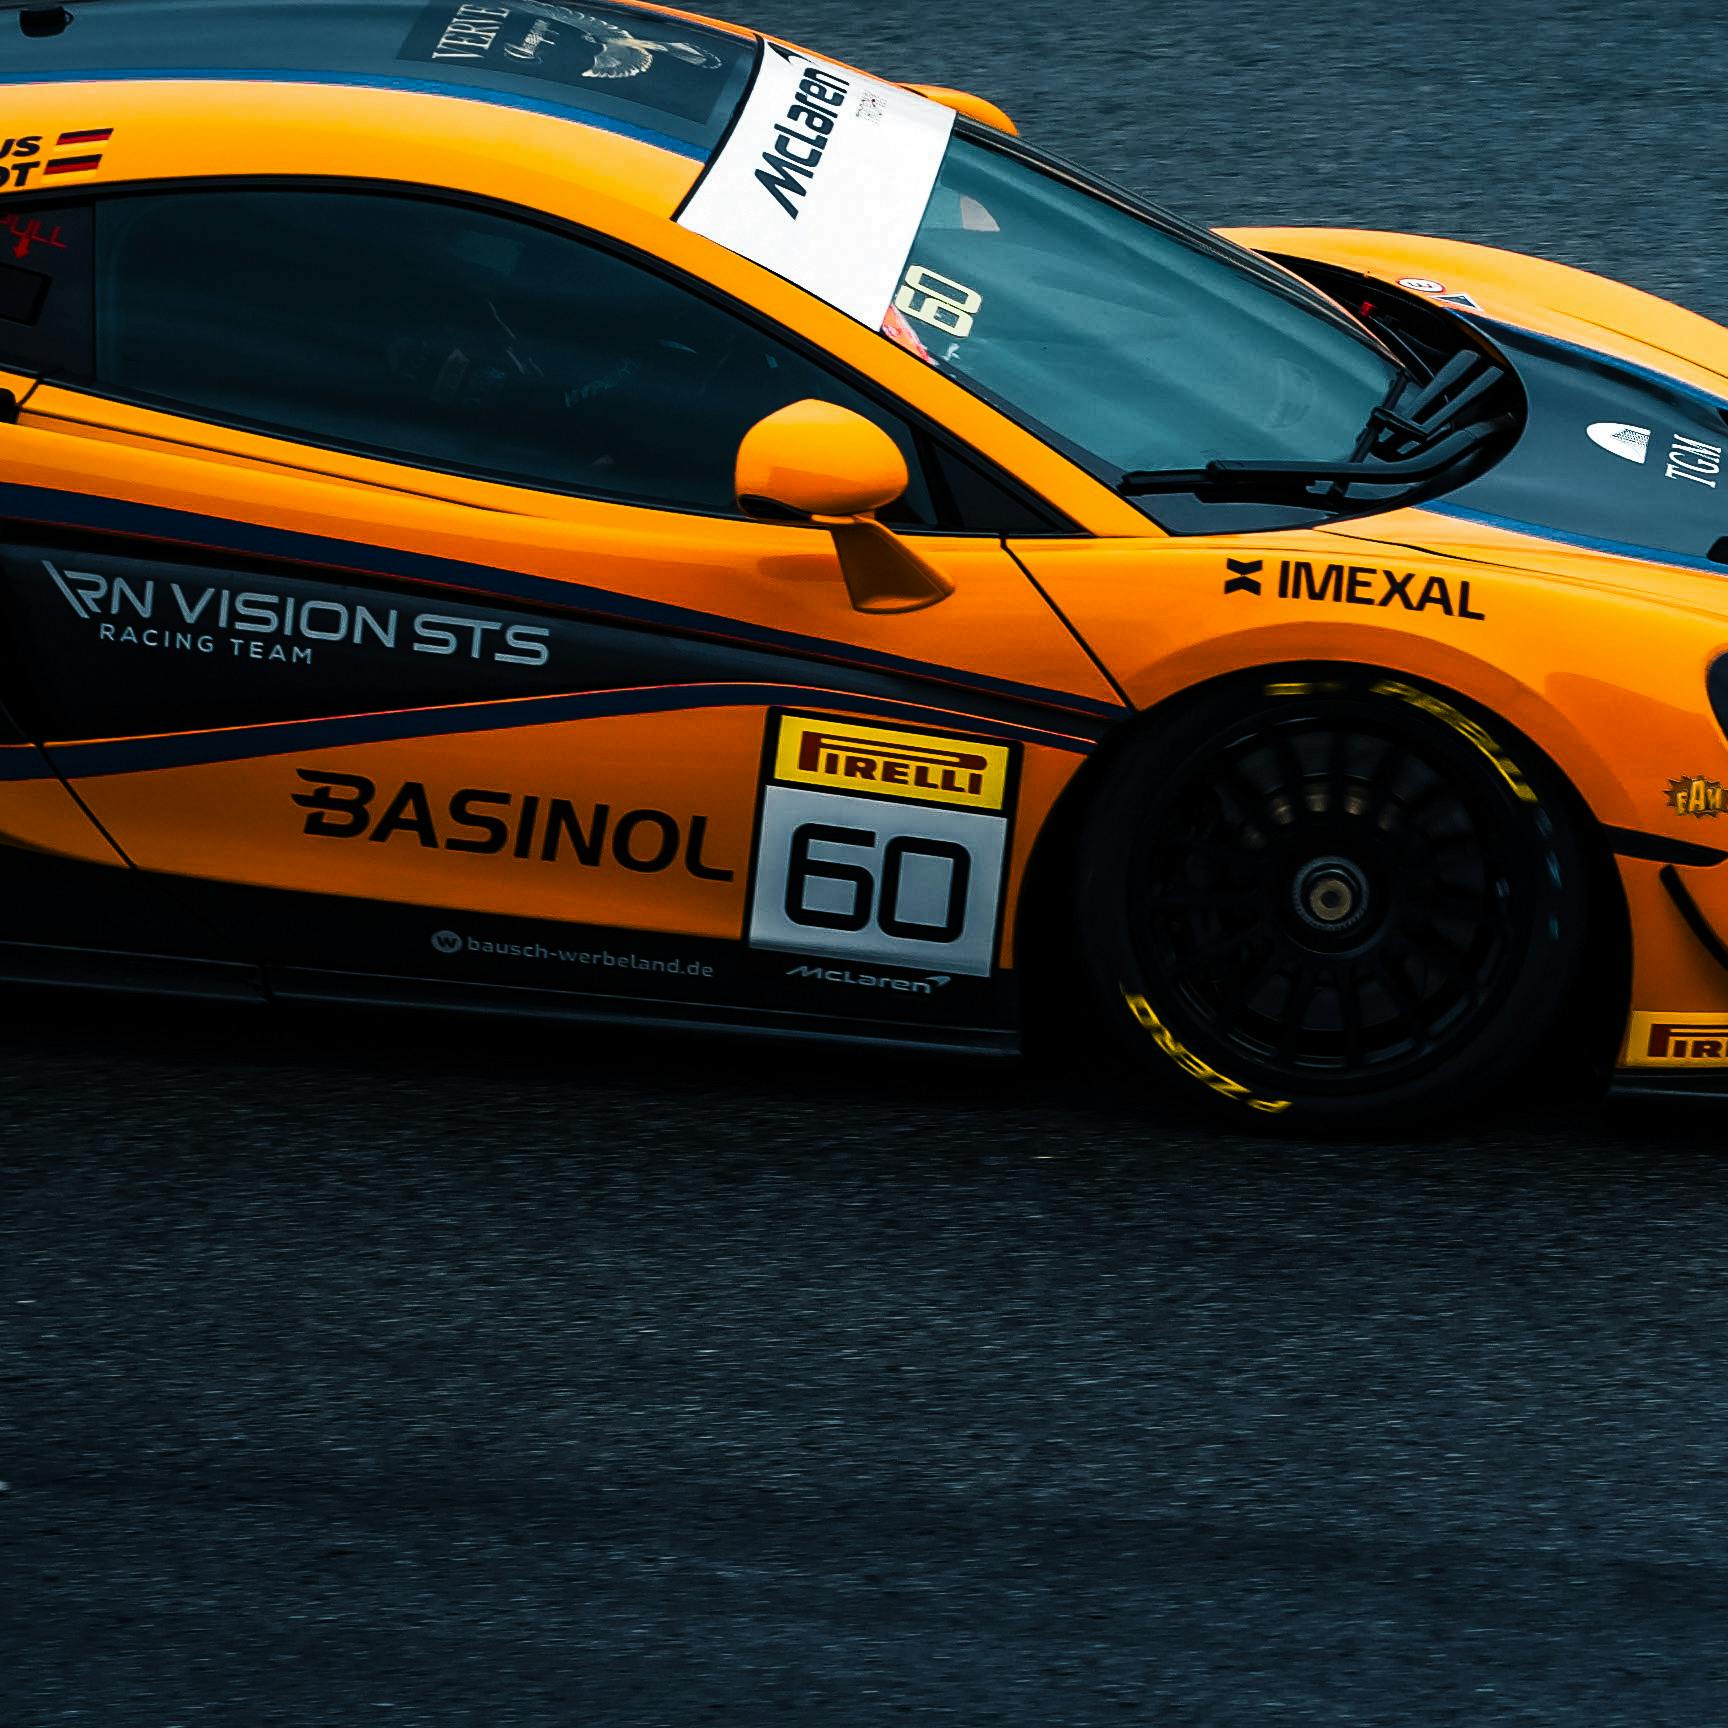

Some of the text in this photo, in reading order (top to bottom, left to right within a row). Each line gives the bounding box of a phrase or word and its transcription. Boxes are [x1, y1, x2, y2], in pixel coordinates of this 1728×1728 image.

[432, 3, 511, 59] VERVE
[755, 67, 850, 221] McLaren
[894, 264, 982, 339] 60
[1664, 433, 1722, 489] TGM
[1278, 559, 1486, 621] IMEXAL
[100, 622, 312, 665] RACING TEAM
[170, 582, 398, 649] VISION
[412, 613, 551, 667] STS
[798, 729, 988, 795] PIRELLI
[291, 768, 735, 883] BASINOL
[784, 822, 972, 944] 60
[467, 936, 714, 978] bausch-werbeland.de
